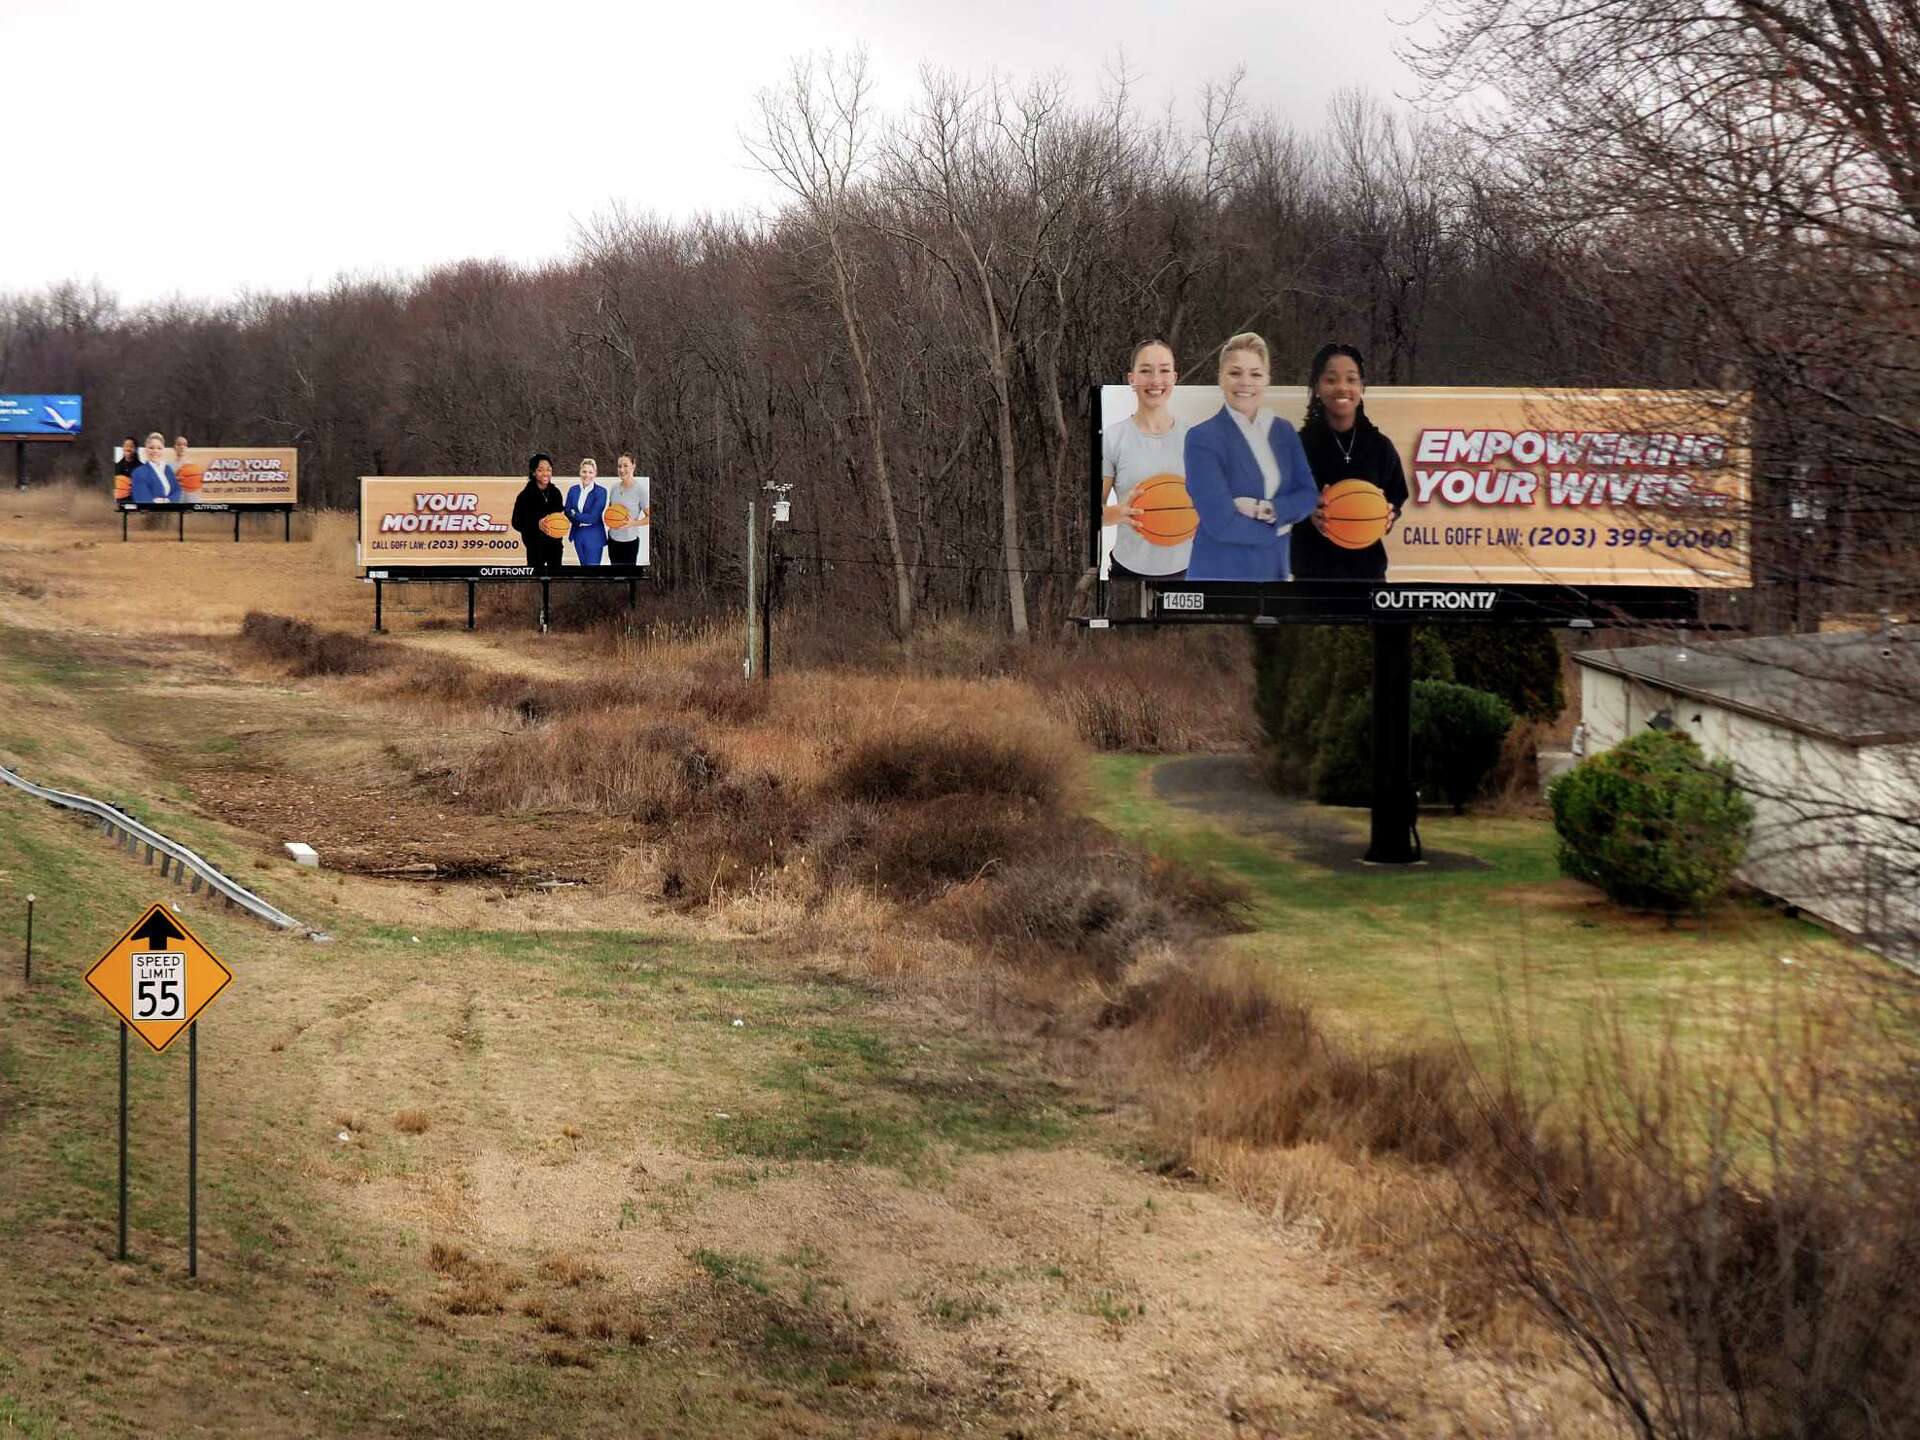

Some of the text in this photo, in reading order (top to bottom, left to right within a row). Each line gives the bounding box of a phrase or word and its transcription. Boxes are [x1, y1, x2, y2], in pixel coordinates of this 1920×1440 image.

[1415, 429, 1727, 466] EMPOWERING
[210, 459, 281, 470] AND YOUR
[203, 471, 290, 482] DAUGHTERS!
[1414, 470, 1539, 505] YOUR
[415, 493, 478, 512] YOUR
[381, 514, 508, 533] MOTHERS...
[372, 541, 388, 550] CALL
[428, 540, 459, 550] (203)
[462, 540, 519, 550] 399-0000
[1403, 527, 1734, 549] CALL GOFF LAW: (203) 399-0000
[1164, 594, 1203, 608] 1405B
[137, 956, 181, 967] SPEED
[141, 968, 176, 979] LIMIT
[138, 981, 180, 1017] 55
